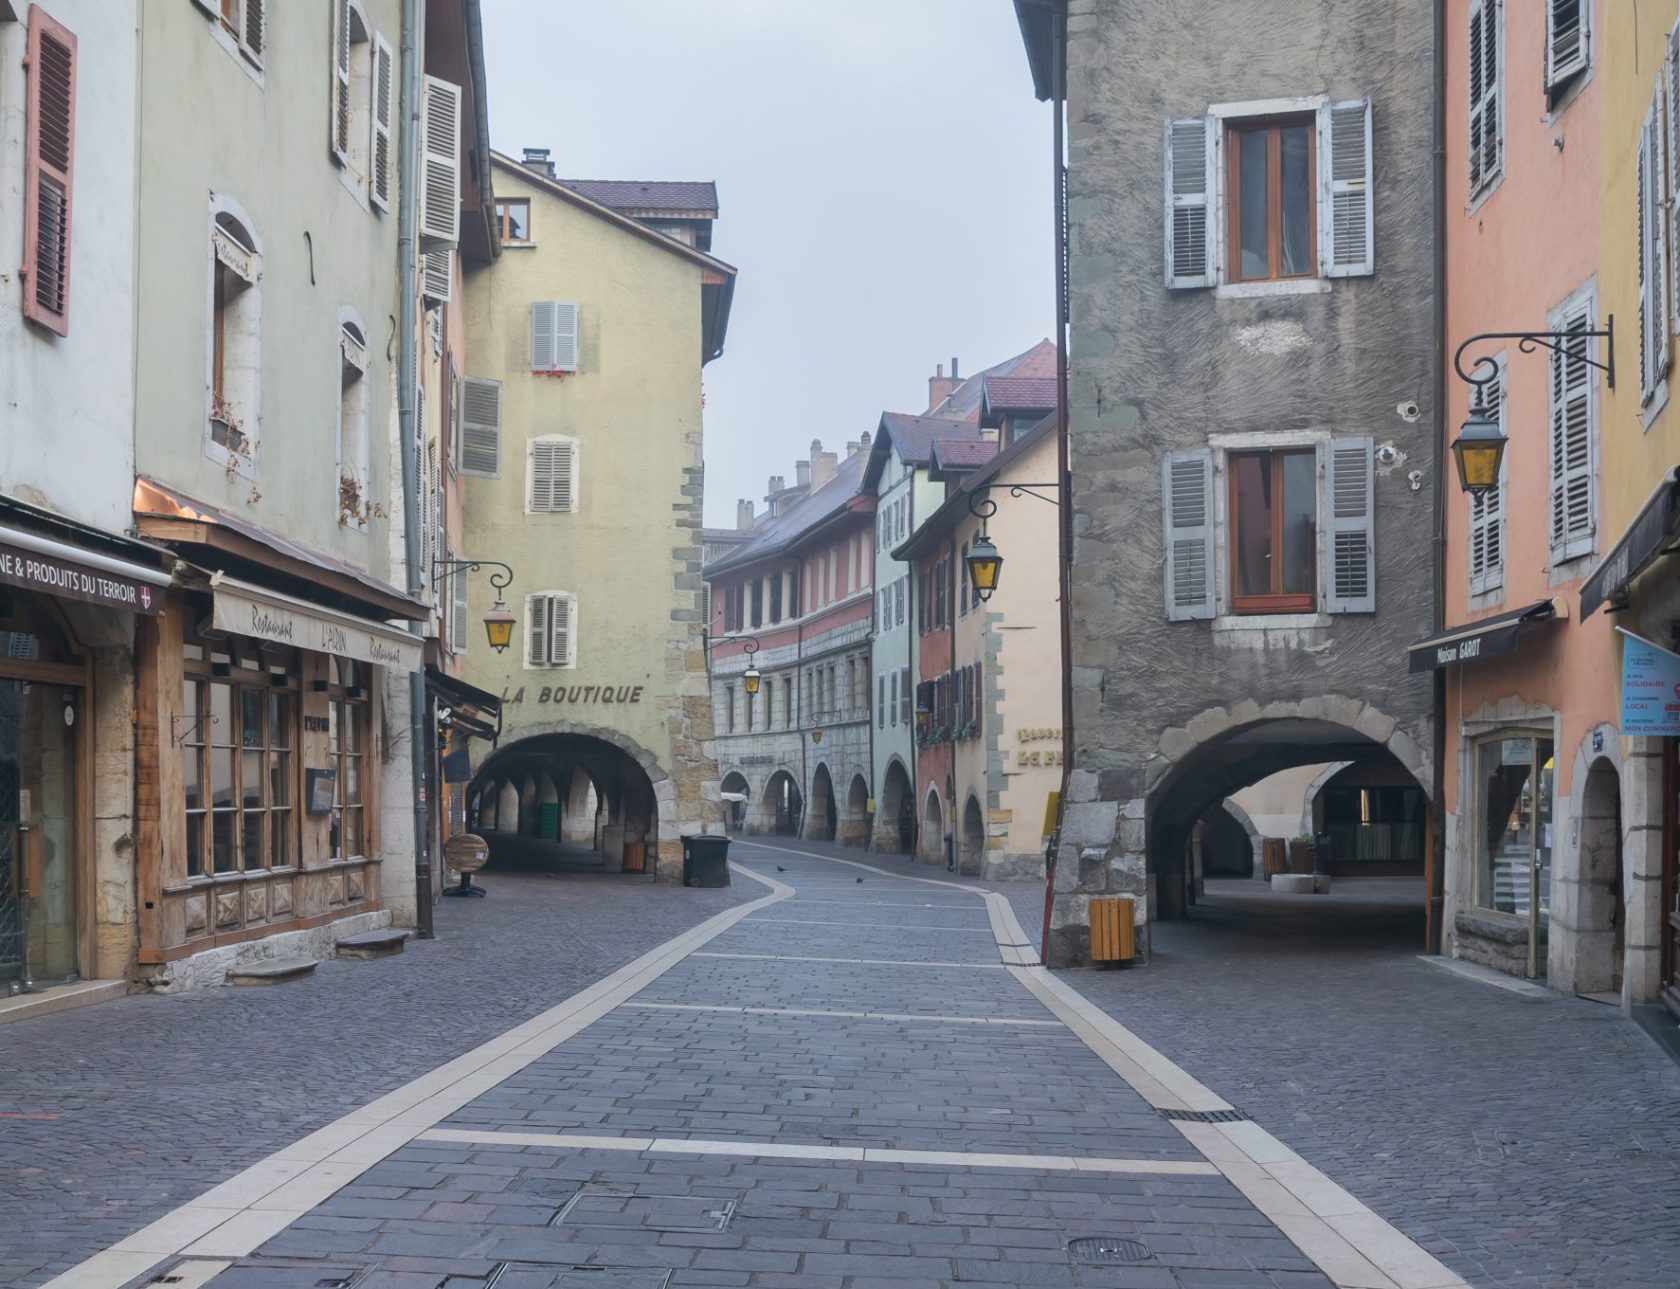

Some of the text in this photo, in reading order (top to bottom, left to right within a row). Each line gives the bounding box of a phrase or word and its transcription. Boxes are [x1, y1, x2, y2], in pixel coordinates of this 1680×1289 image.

[15, 557, 24, 577] &
[26, 560, 79, 590] PRODUITS
[81, 574, 96, 594] DU
[97, 578, 137, 604] TERROIR
[252, 604, 293, 640] Restaurant
[369, 636, 401, 665] Restaurant
[1437, 638, 1481, 664] Maison GAROT
[501, 685, 644, 704] LA BOUTIQUE
[1626, 680, 1666, 688] SOLIDAIRE
